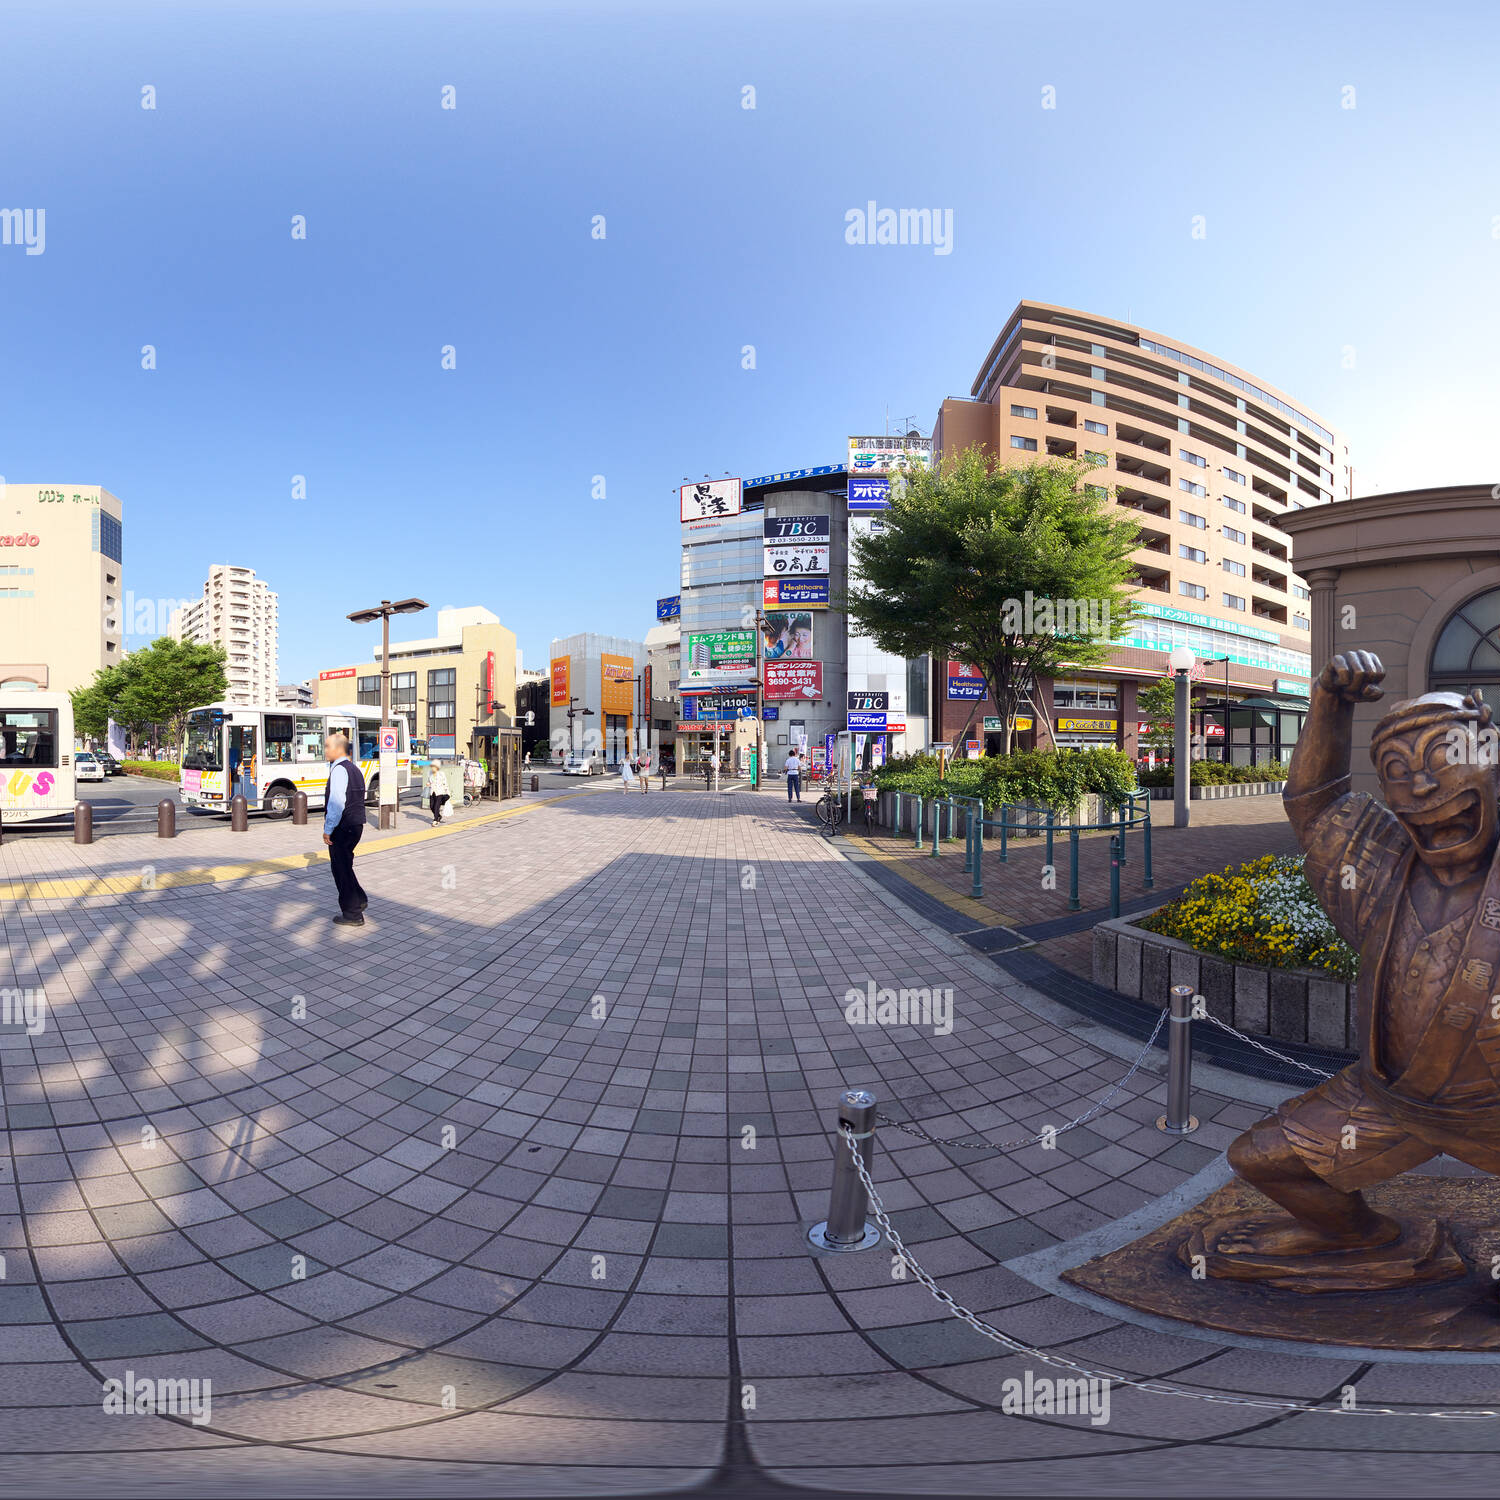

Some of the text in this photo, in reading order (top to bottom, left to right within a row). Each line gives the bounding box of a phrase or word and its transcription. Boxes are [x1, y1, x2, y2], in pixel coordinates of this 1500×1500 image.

[776, 522, 816, 535] TBC
[0, 532, 40, 547] ado
[773, 556, 822, 572] 日高屋
[765, 586, 778, 599] 薬
[780, 591, 827, 599] セイジョー
[853, 698, 883, 709] TBC
